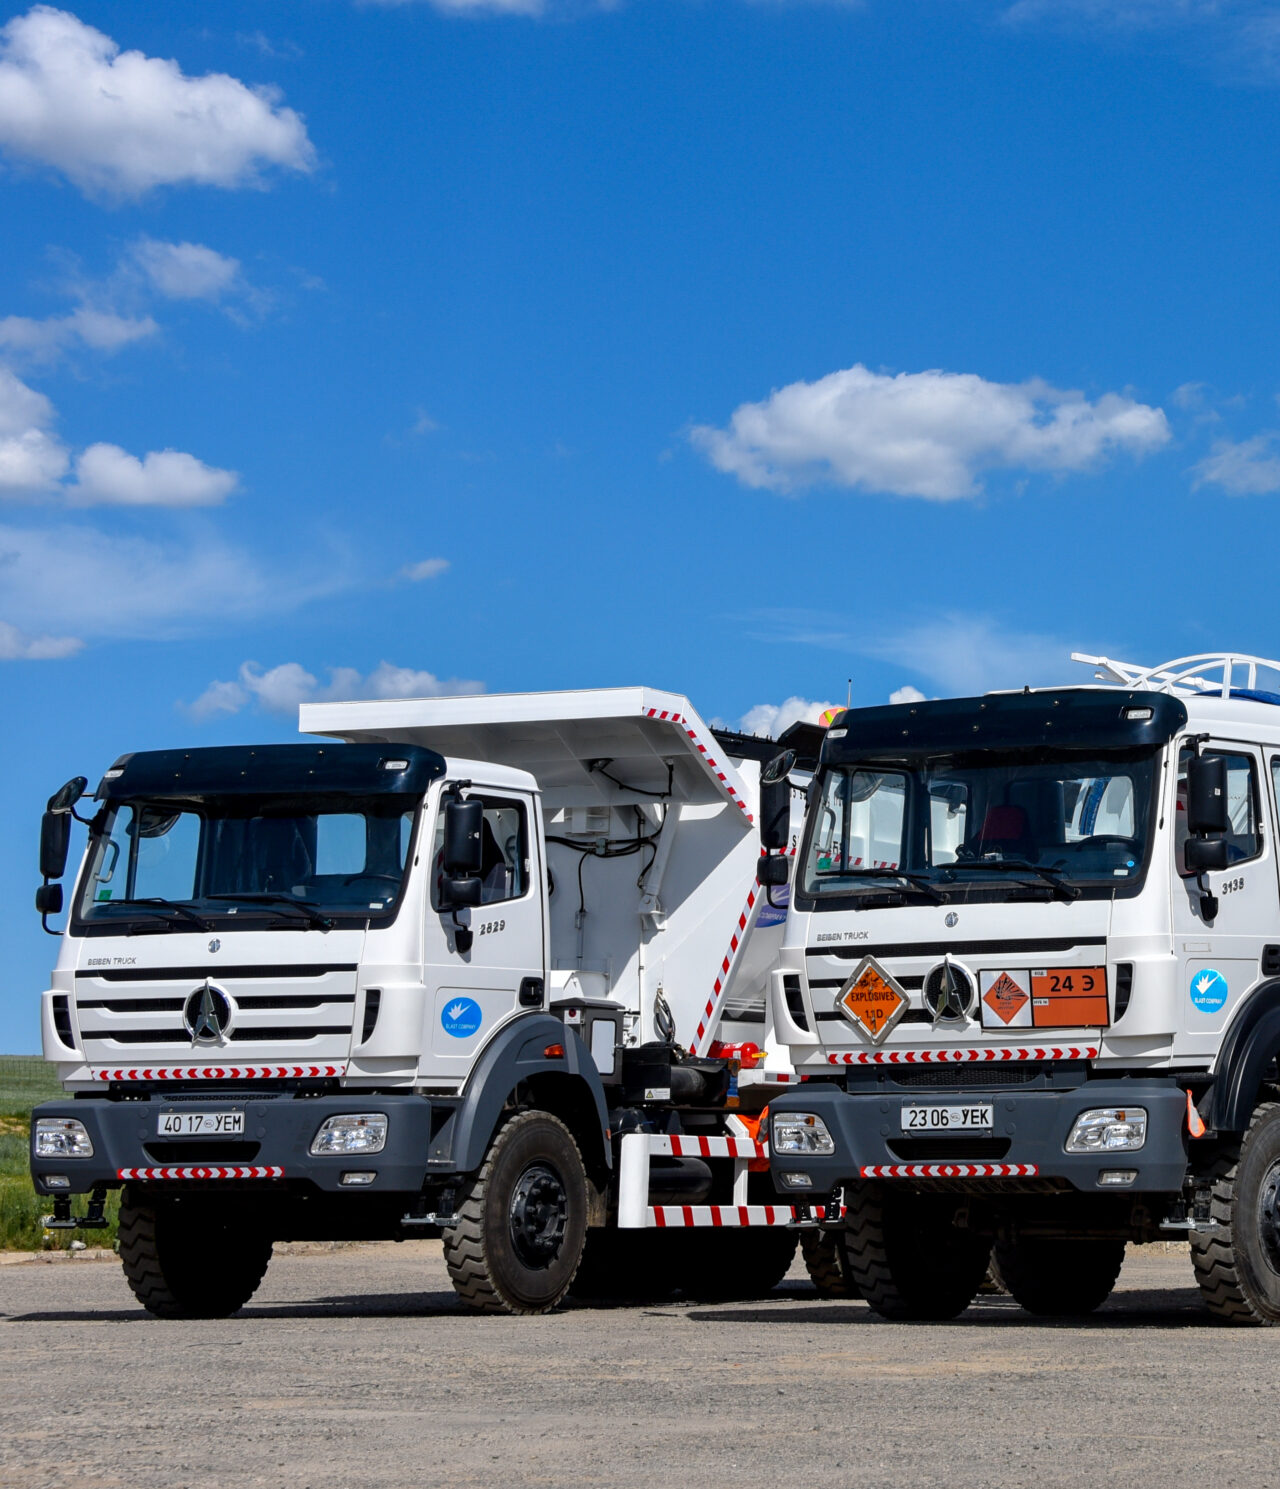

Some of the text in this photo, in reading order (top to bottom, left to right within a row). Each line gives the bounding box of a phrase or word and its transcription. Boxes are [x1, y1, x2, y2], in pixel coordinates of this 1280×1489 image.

[479, 919, 506, 936] 2829
[816, 931, 869, 942] BEIBEN TRUCK
[87, 957, 137, 966] BEIBEN TRUCK
[1050, 975, 1095, 992] 24 Э
[850, 991, 895, 1002] EXPLOSIVES
